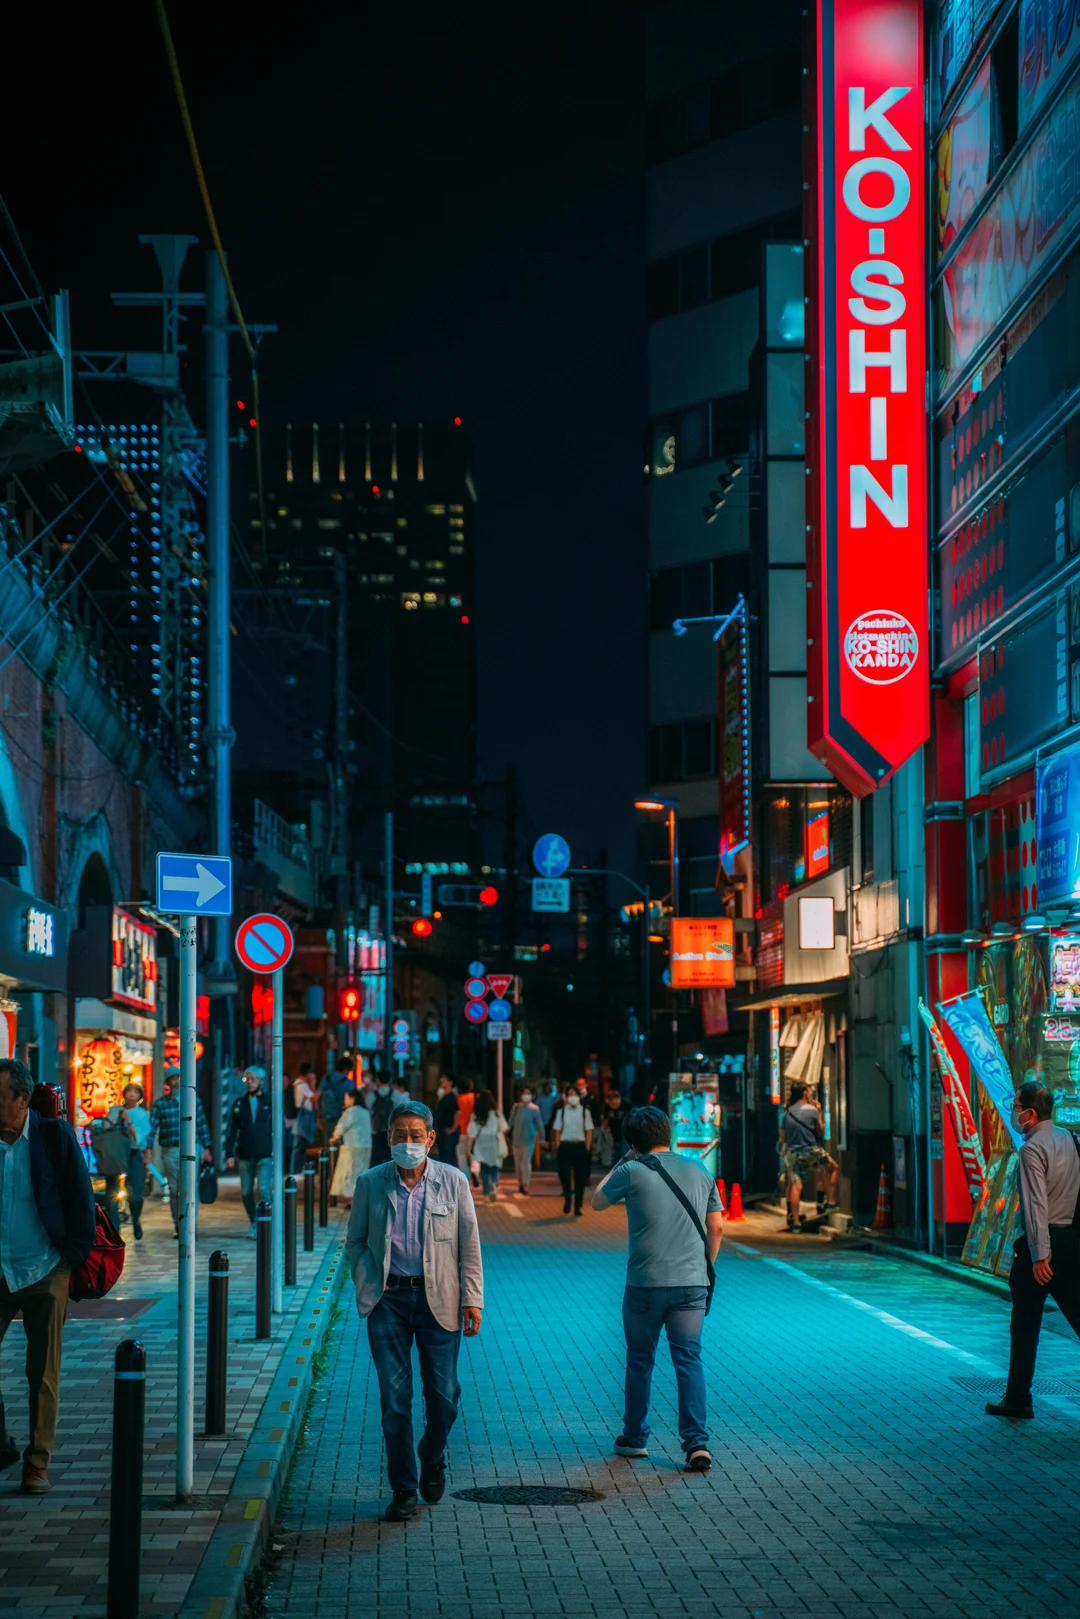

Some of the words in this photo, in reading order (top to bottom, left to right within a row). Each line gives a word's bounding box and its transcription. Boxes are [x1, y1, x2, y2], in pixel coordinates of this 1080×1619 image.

[857, 618, 906, 631] pachinko
[847, 640, 917, 654] KO-SHIN
[851, 653, 912, 667] KANDA
